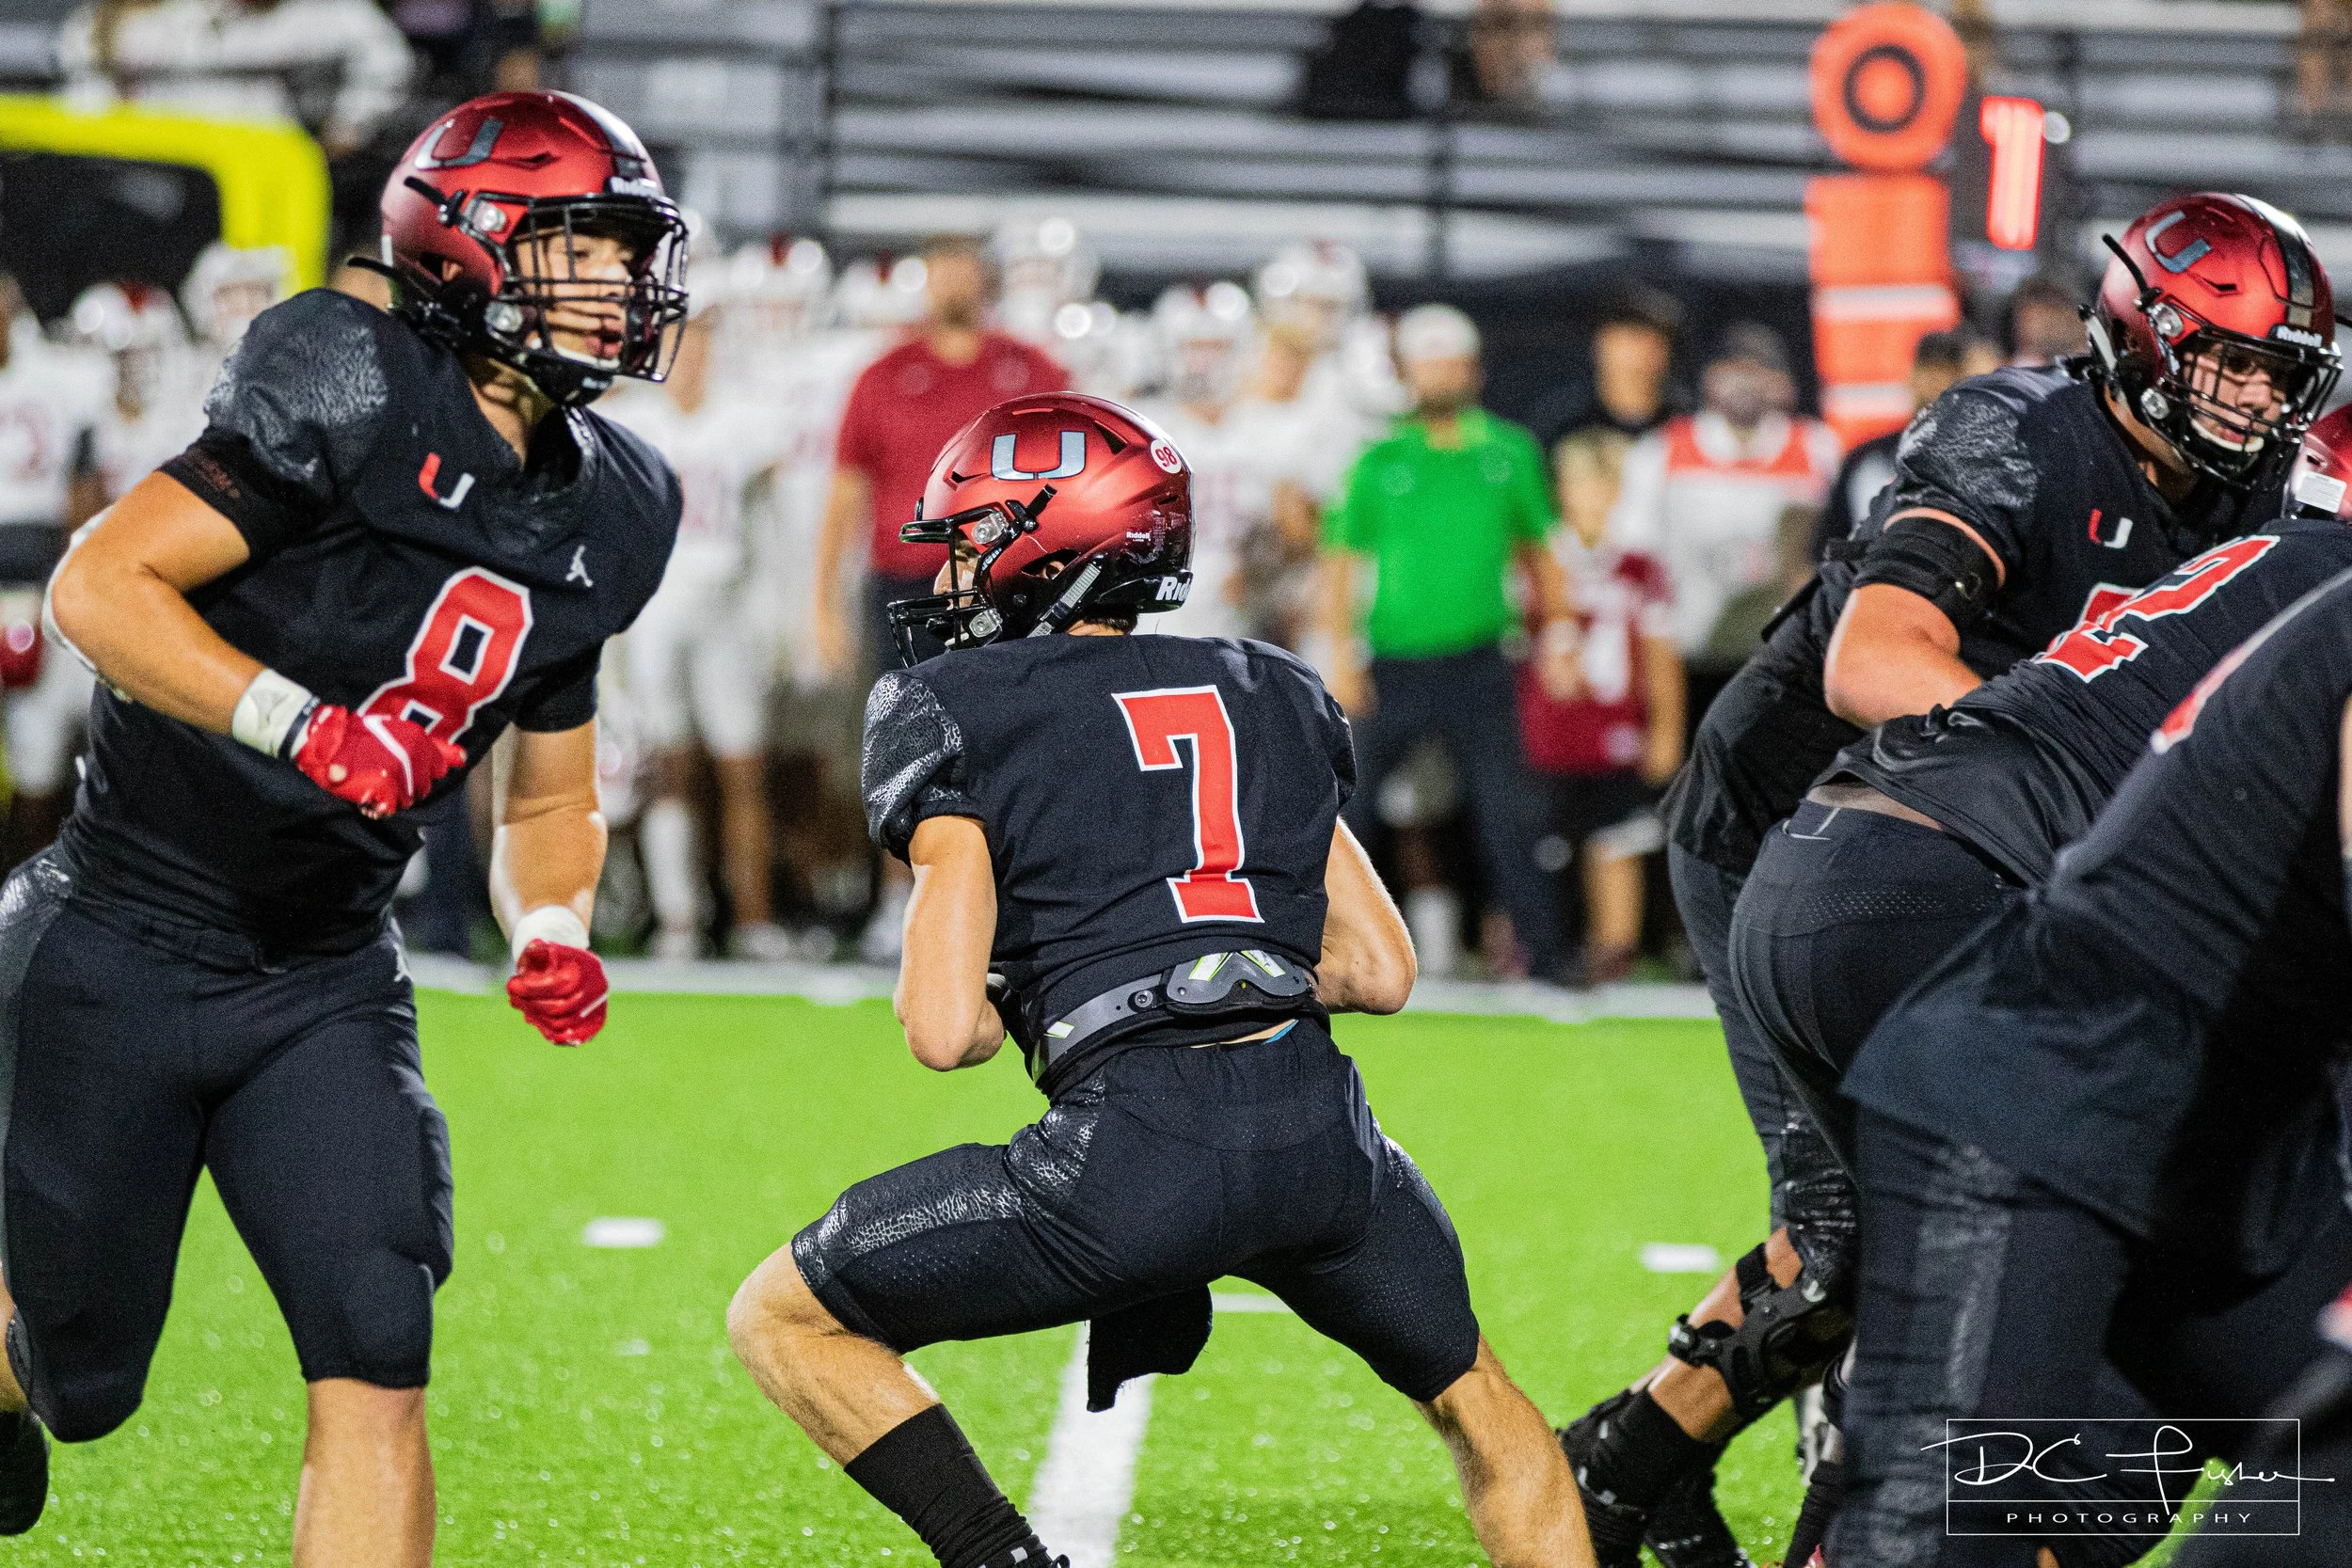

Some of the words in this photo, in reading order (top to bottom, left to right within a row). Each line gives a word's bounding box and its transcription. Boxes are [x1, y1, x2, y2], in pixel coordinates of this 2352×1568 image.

[413, 116, 504, 171] U
[1979, 96, 2044, 250] 1
[2143, 210, 2212, 274] U
[419, 451, 474, 509] U
[991, 430, 1087, 482] U
[1154, 445, 1178, 467] 98
[2088, 508, 2134, 549] U
[356, 565, 534, 745] 8
[1111, 684, 1265, 924] 7
